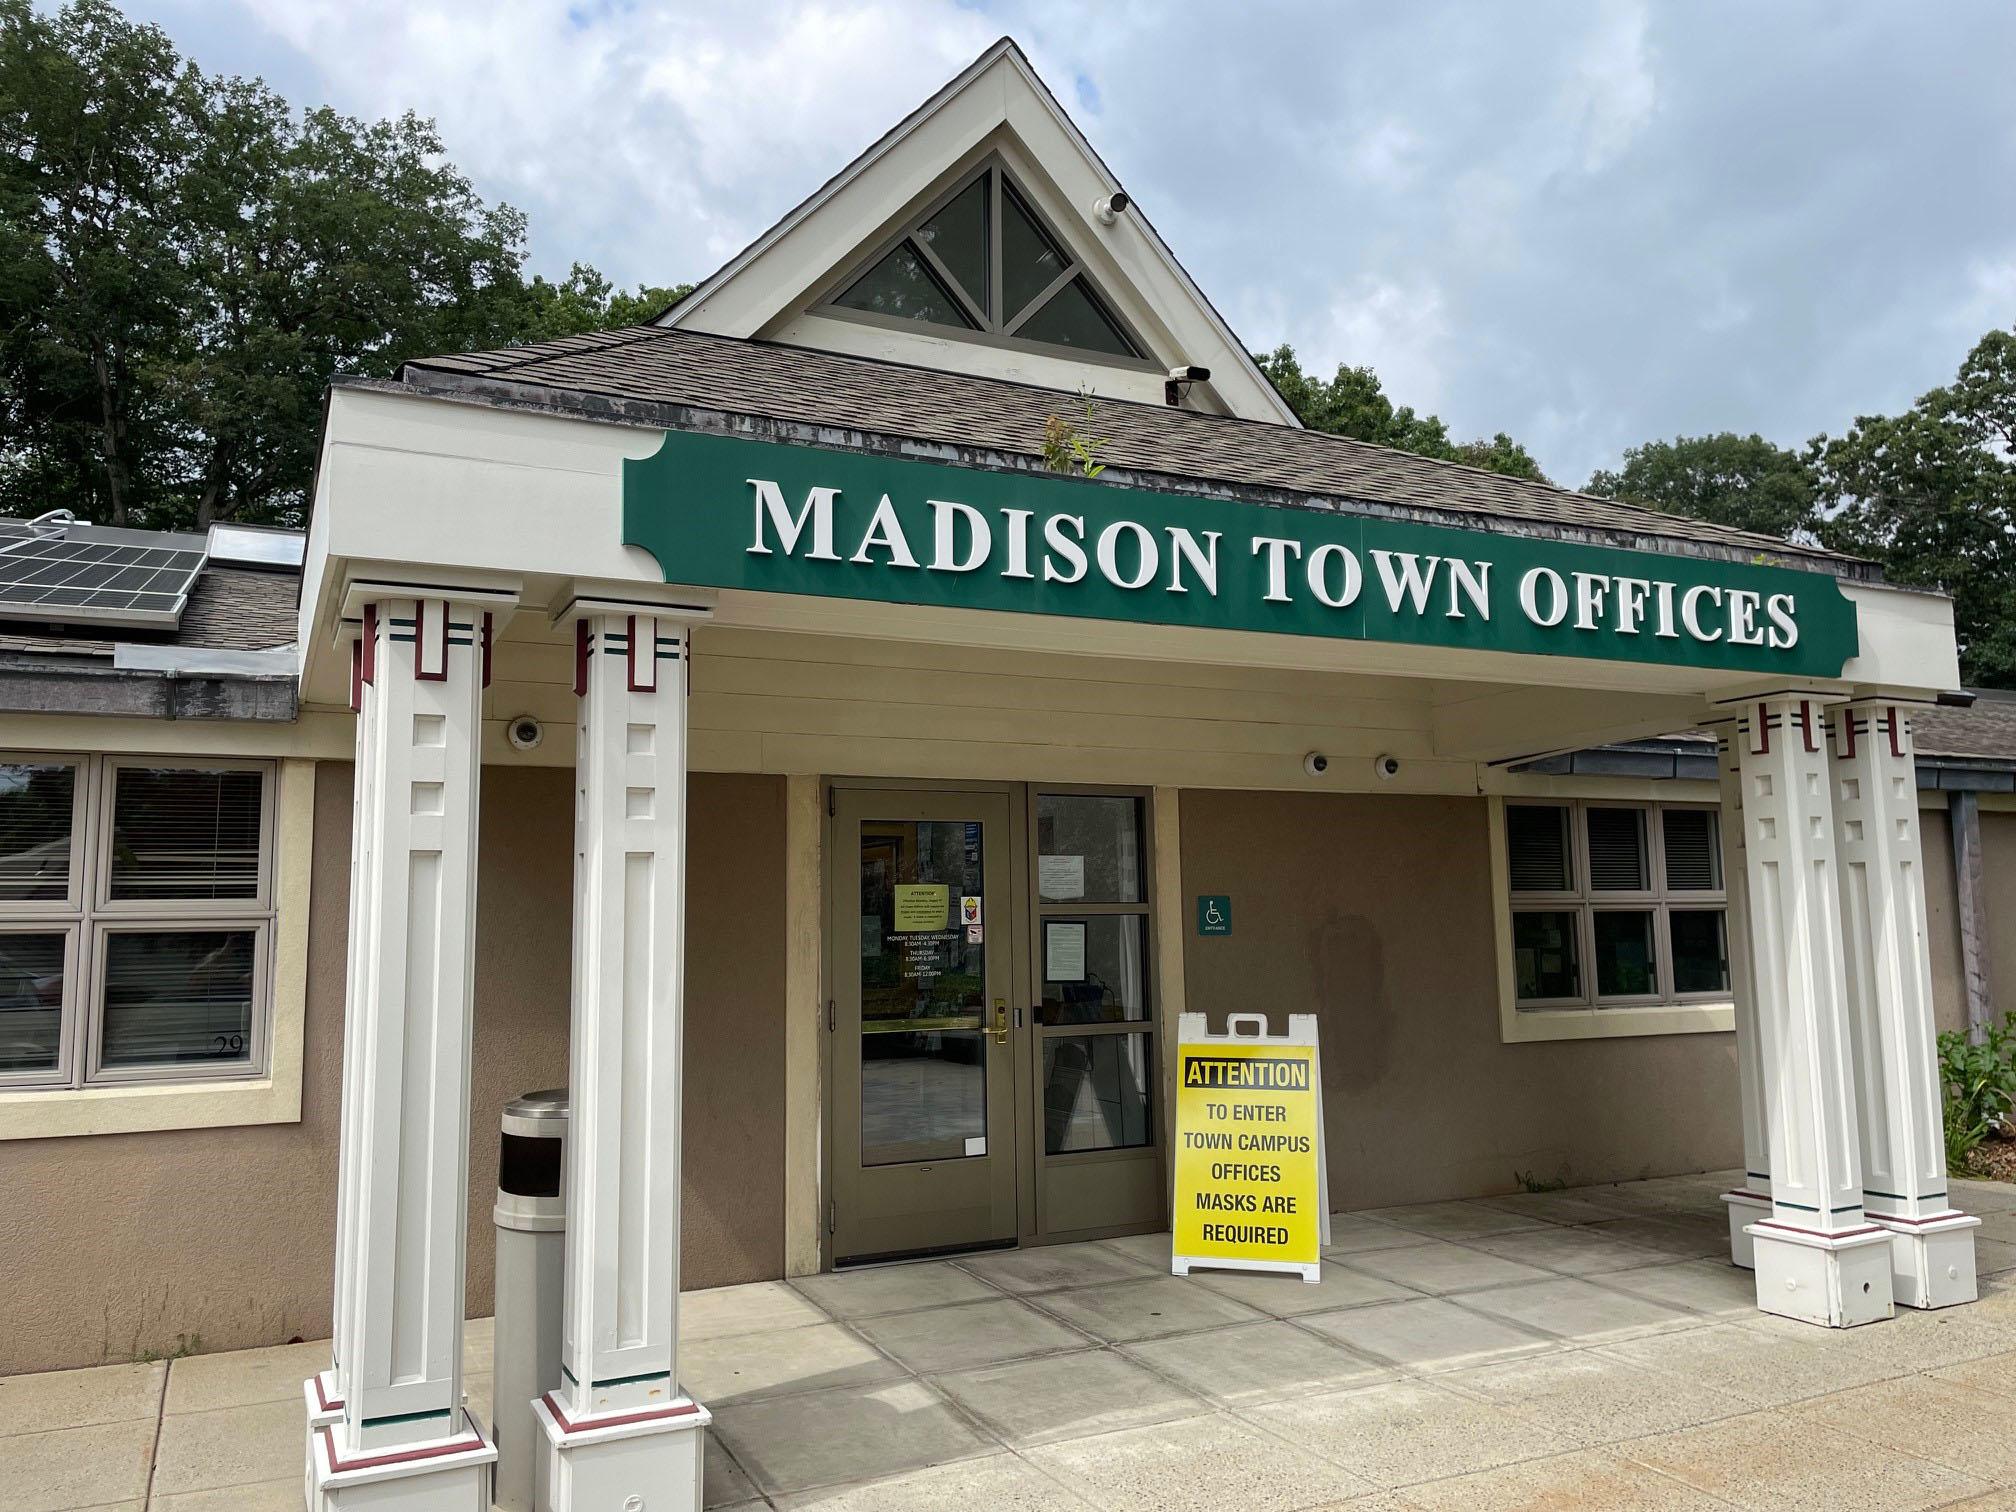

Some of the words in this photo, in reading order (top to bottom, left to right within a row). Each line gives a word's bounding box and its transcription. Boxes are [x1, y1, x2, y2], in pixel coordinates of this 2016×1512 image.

[746, 478, 1222, 597] MADISON
[1252, 536, 1493, 621] TOWN
[1520, 567, 1799, 649] OFFICES
[214, 1034, 244, 1058] 29
[1187, 1061, 1306, 1088] ATTENTION
[1206, 1103, 1228, 1121] TO
[1233, 1105, 1287, 1122] ENTER
[1184, 1132, 1232, 1150] TOWN
[1238, 1133, 1310, 1153] CAMPUS
[1211, 1162, 1281, 1183] OFFICES
[1196, 1192, 1257, 1213] MASKS
[1262, 1196, 1297, 1214] ARE
[1203, 1223, 1289, 1246] REQUIRED
